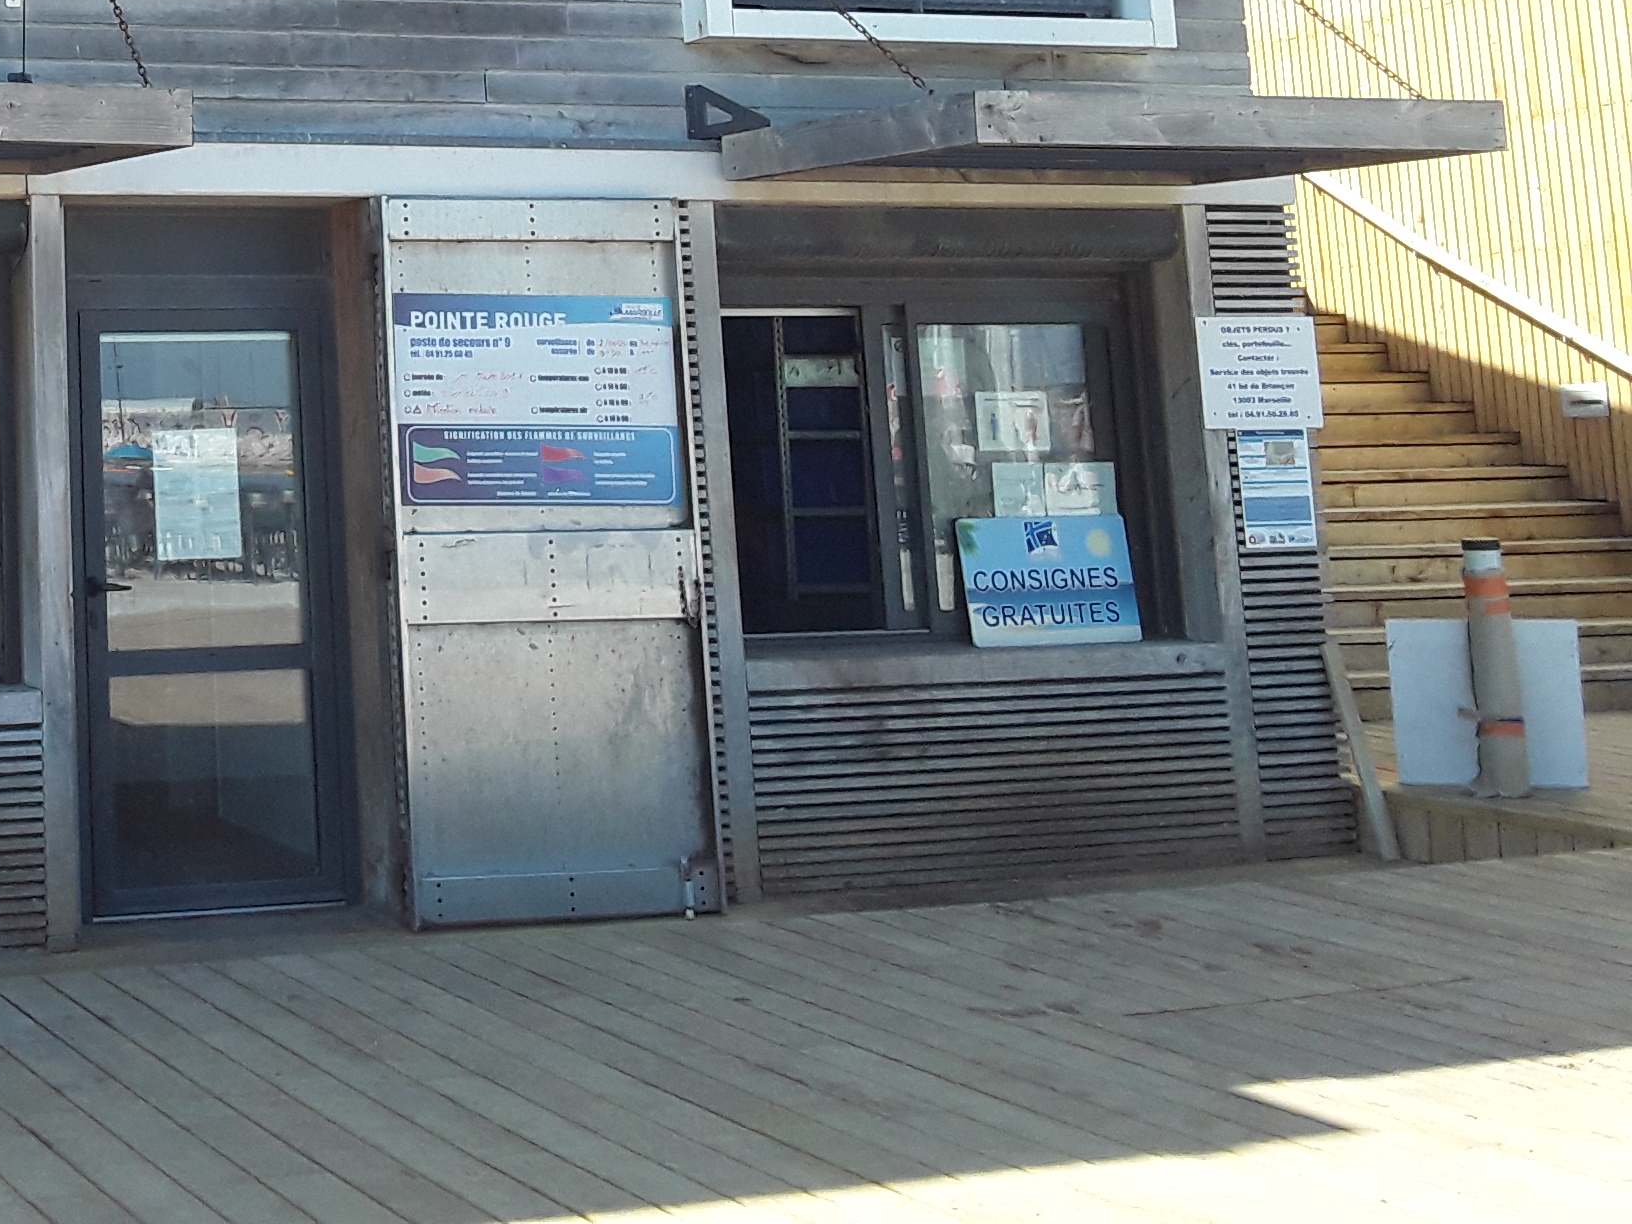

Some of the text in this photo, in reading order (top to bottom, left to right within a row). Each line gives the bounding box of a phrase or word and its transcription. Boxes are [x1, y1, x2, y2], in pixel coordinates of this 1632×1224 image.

[409, 311, 567, 330] POINTE ROUGE
[410, 337, 437, 348] poste
[504, 337, 511, 348] 9
[1256, 369, 1279, 377] objets
[444, 430, 505, 440] SIGNIFICATION
[507, 431, 523, 440] DES
[524, 431, 563, 441] FLAMMES
[576, 431, 636, 441] SURVEILLANCE
[972, 566, 1119, 593] CONSIGNES
[981, 601, 1121, 628] GRATUITES
